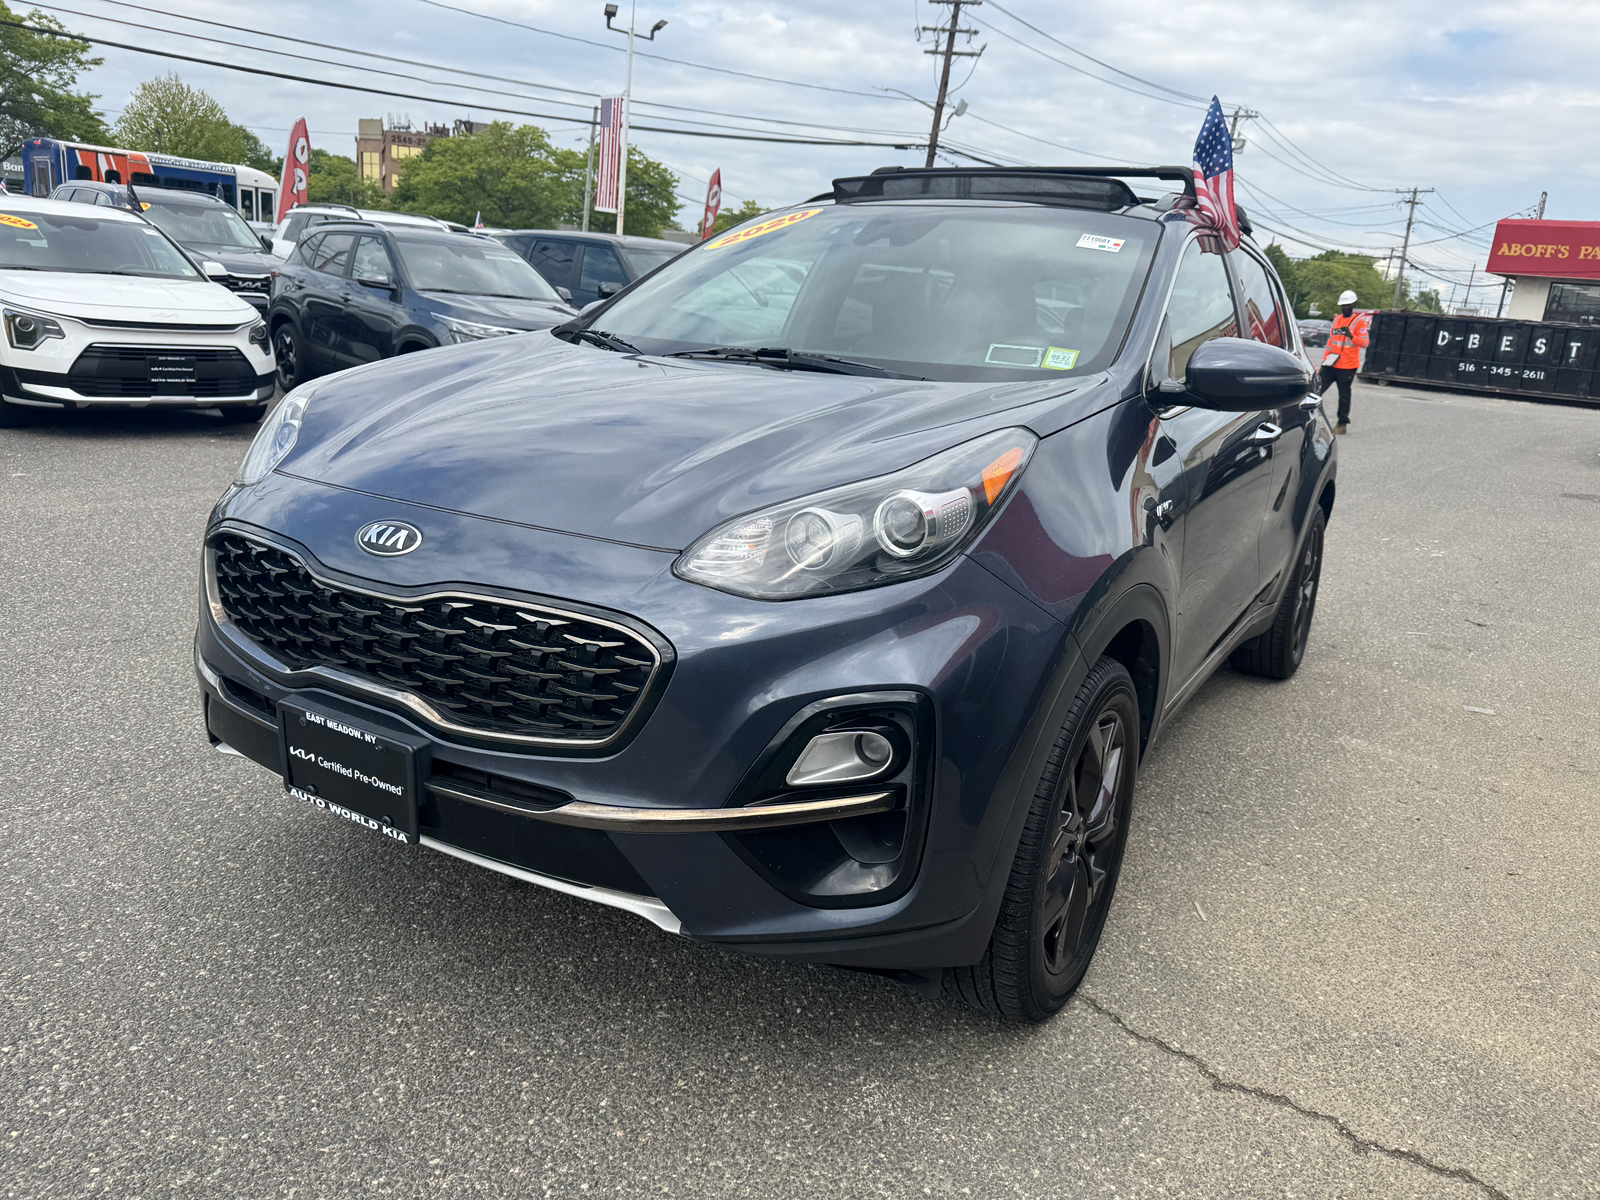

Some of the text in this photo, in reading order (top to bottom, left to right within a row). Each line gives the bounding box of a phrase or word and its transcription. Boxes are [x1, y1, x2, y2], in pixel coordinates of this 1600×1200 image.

[719, 211, 810, 247] 2020
[1497, 243, 1570, 259] ABOFF'S
[1458, 363, 1476, 372] 516
[1490, 367, 1511, 376] 345
[1522, 370, 1545, 379] 2611
[363, 524, 409, 550] KIA
[306, 712, 325, 726] EAST
[364, 733, 377, 744] NY
[318, 757, 353, 778] Certified
[354, 771, 402, 796] Pre-Owned
[290, 788, 408, 844] AUTO WORLD KIA
